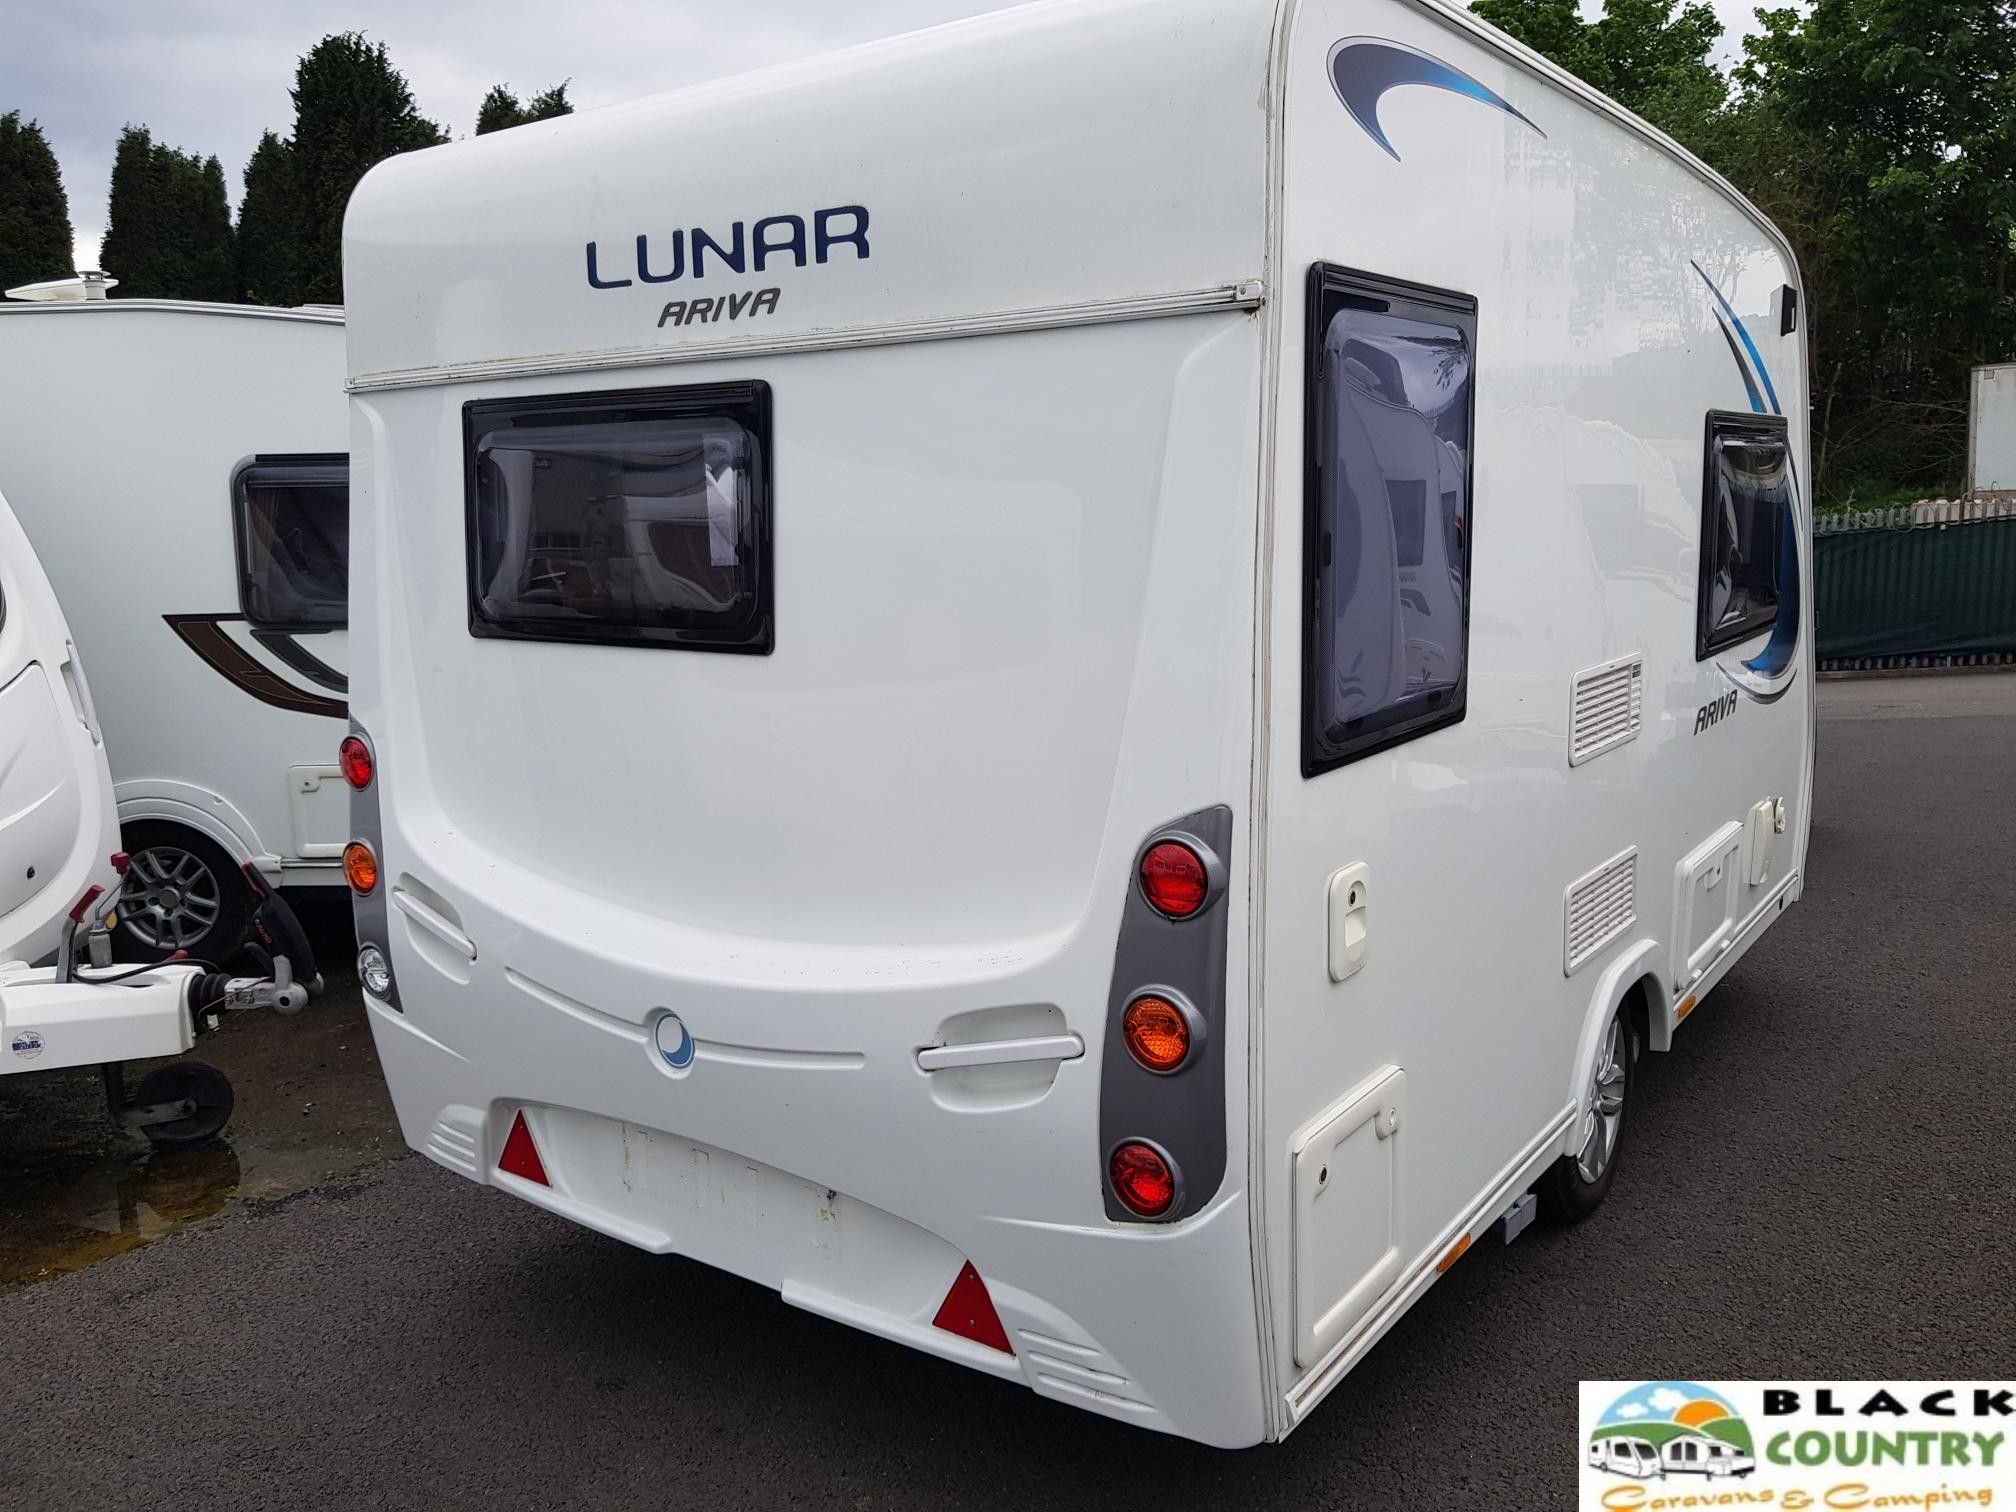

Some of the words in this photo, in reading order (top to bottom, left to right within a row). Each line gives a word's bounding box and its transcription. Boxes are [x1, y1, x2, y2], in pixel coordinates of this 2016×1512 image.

[586, 204, 870, 289] LUNAR
[657, 287, 781, 328] ARIVA
[1693, 688, 1738, 737] ARIVA
